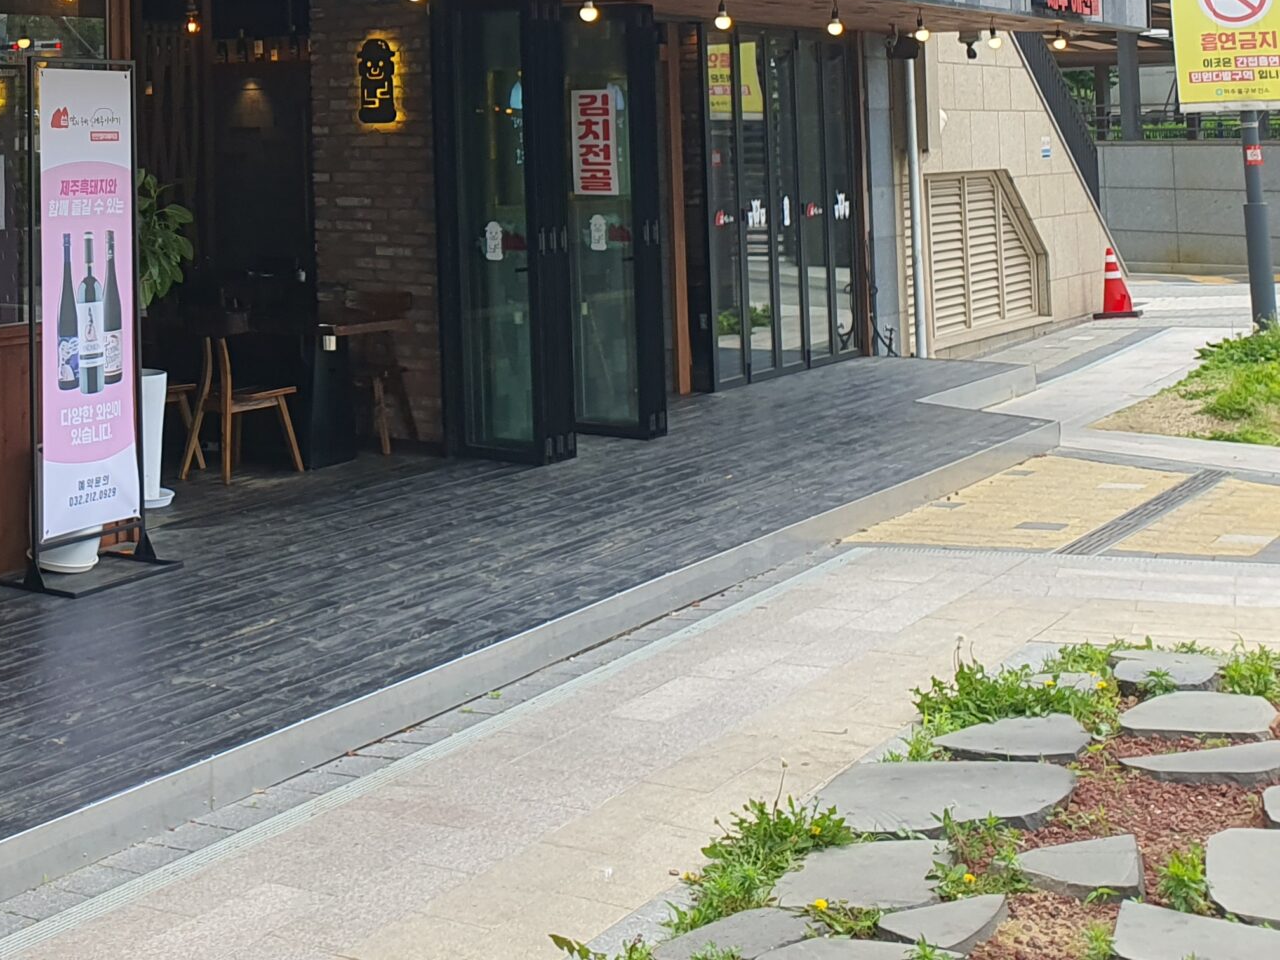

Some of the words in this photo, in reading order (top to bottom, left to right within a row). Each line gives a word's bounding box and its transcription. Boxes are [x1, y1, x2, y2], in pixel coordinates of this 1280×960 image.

[1200, 31, 1277, 52] 흡연금지
[1203, 57, 1232, 68] 이곳은
[1258, 70, 1279, 80] 입니
[577, 94, 612, 191] 김치전골
[60, 177, 118, 196] 제주흑돼지와
[48, 198, 69, 217] 함께
[71, 198, 92, 216] 즐길
[94, 198, 104, 215] 수
[106, 197, 124, 214] 있는
[61, 406, 93, 426] 다양한
[96, 400, 121, 420] 와인이
[69, 487, 117, 507] 032.212.0929
